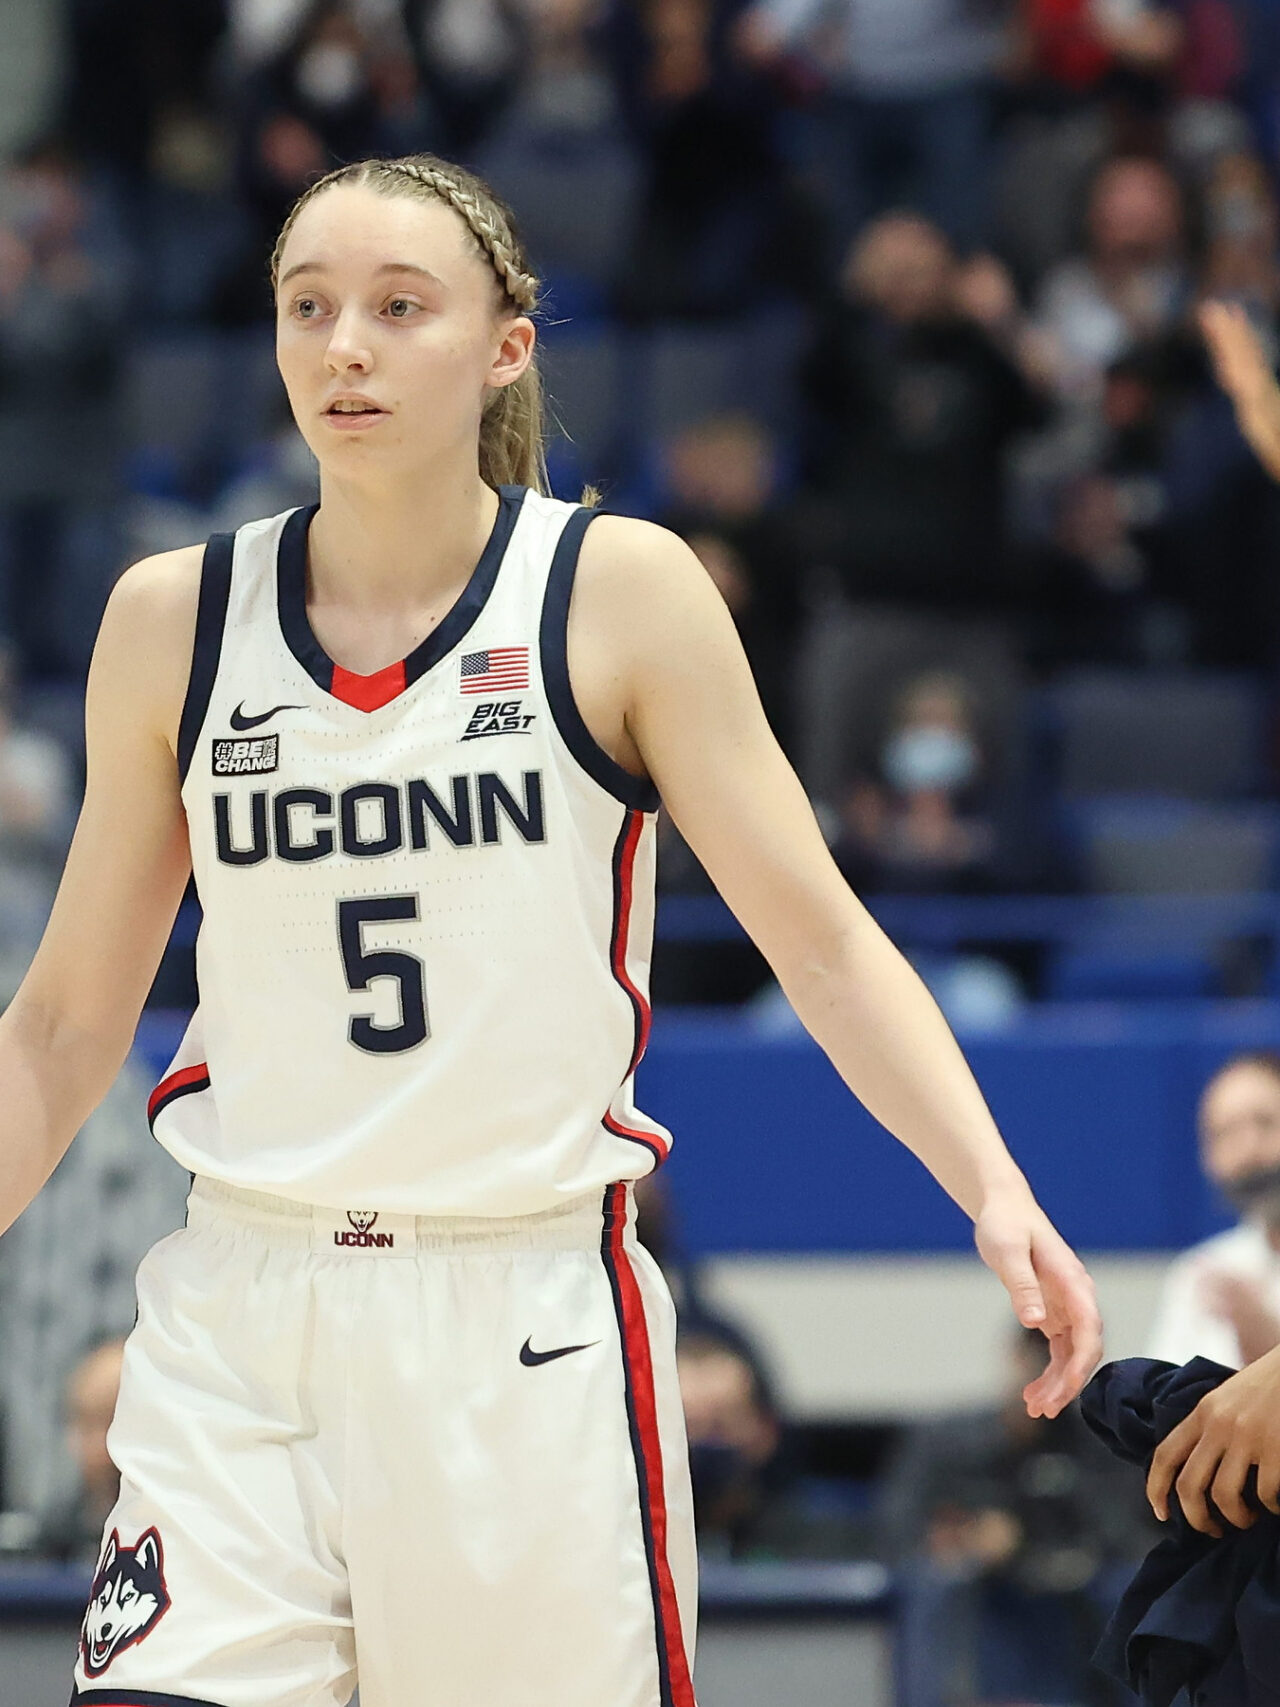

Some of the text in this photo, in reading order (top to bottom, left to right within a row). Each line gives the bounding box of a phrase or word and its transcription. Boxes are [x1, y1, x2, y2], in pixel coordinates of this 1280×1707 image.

[472, 700, 522, 719] BIG
[465, 715, 537, 733] EAST
[212, 769, 547, 868] UCONN
[335, 892, 431, 1057] 5
[334, 1231, 393, 1247] UCONN
